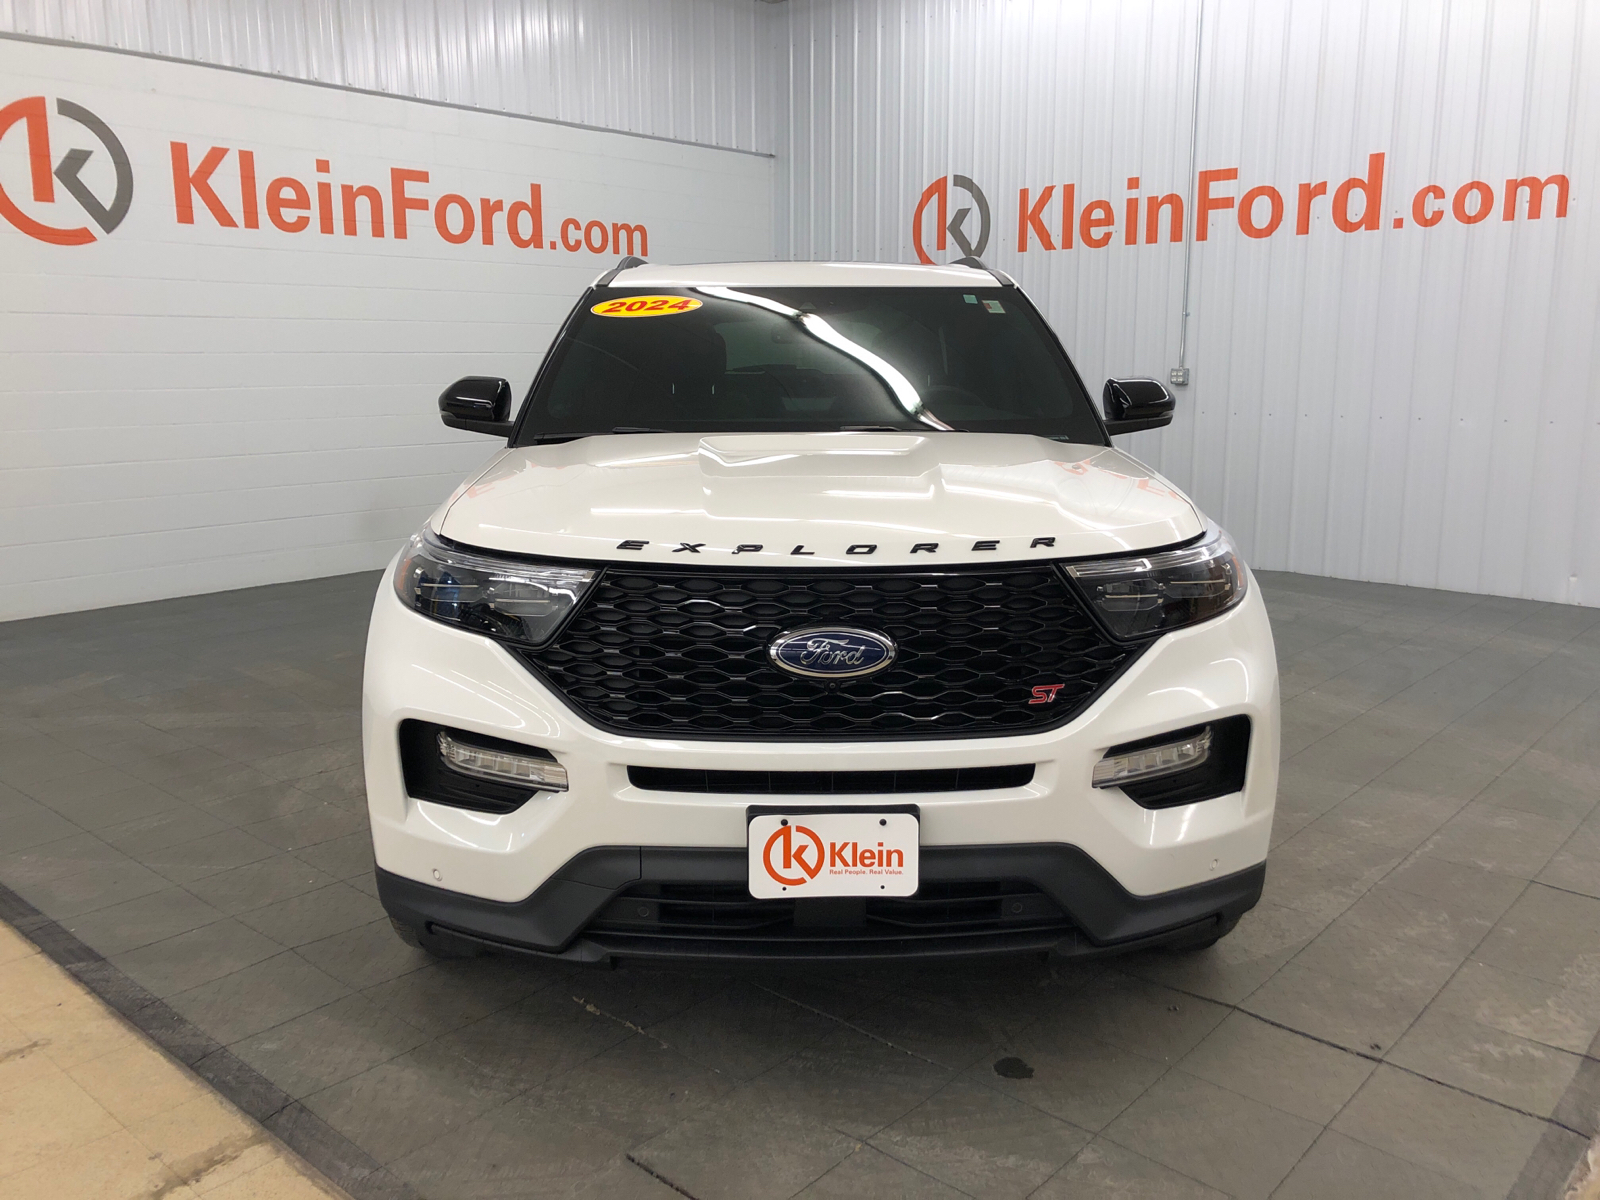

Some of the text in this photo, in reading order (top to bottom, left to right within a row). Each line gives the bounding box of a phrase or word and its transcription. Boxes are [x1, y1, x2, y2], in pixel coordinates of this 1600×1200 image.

[170, 141, 649, 258] KleinFord.com
[1018, 152, 1569, 253] KleinFord.com
[601, 299, 693, 314] 2024
[616, 536, 1057, 556] EXPLORER
[799, 637, 866, 666] Ford
[1028, 683, 1065, 705] ST
[829, 841, 904, 868] Klein
[844, 868, 868, 876] People.
